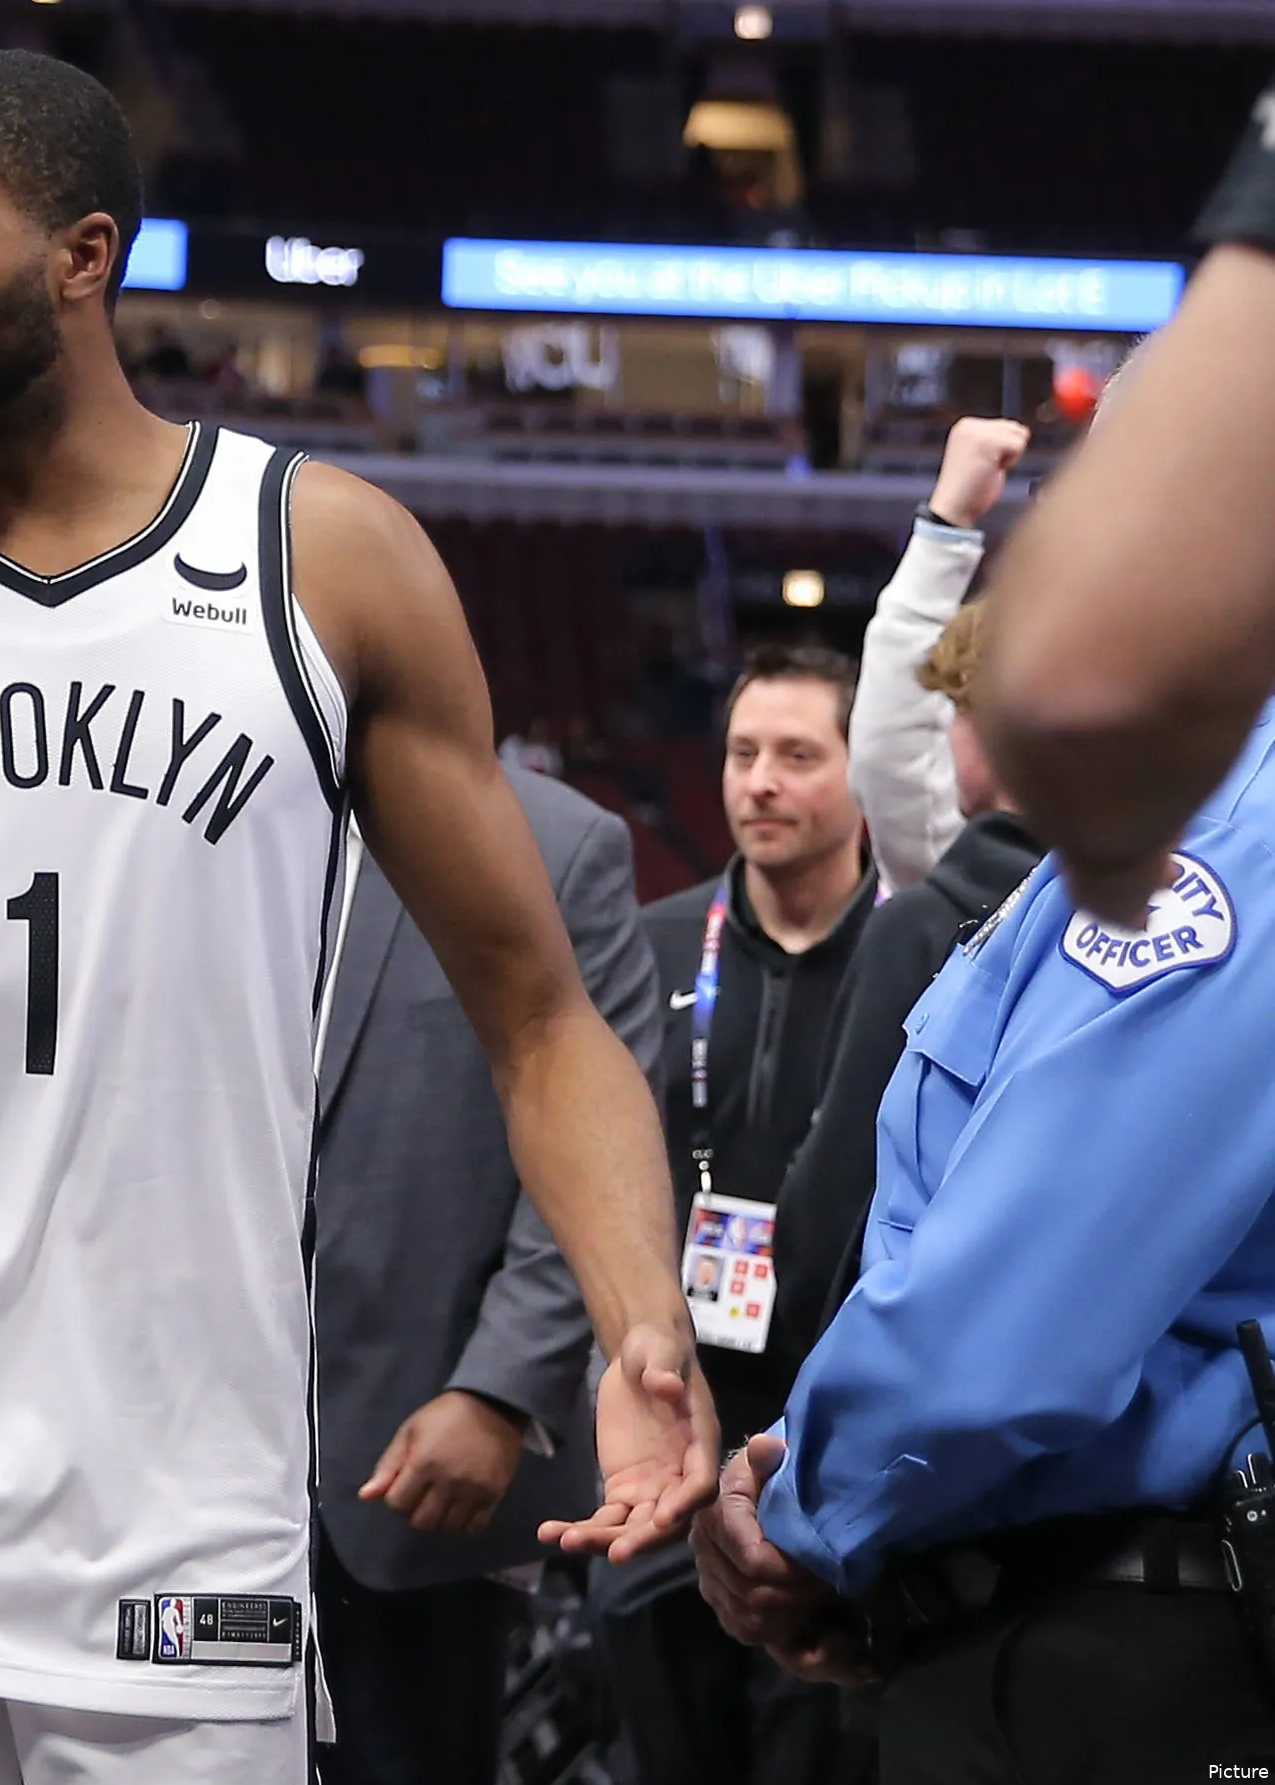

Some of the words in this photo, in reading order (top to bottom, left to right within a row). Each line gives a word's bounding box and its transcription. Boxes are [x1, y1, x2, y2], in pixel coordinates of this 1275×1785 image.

[265, 235, 365, 287] Uber
[171, 597, 248, 626] Webull
[1172, 861, 1225, 922] ITY
[1076, 922, 1205, 968] OFFICER
[6, 872, 60, 1076] 1
[199, 1614, 214, 1626] 48
